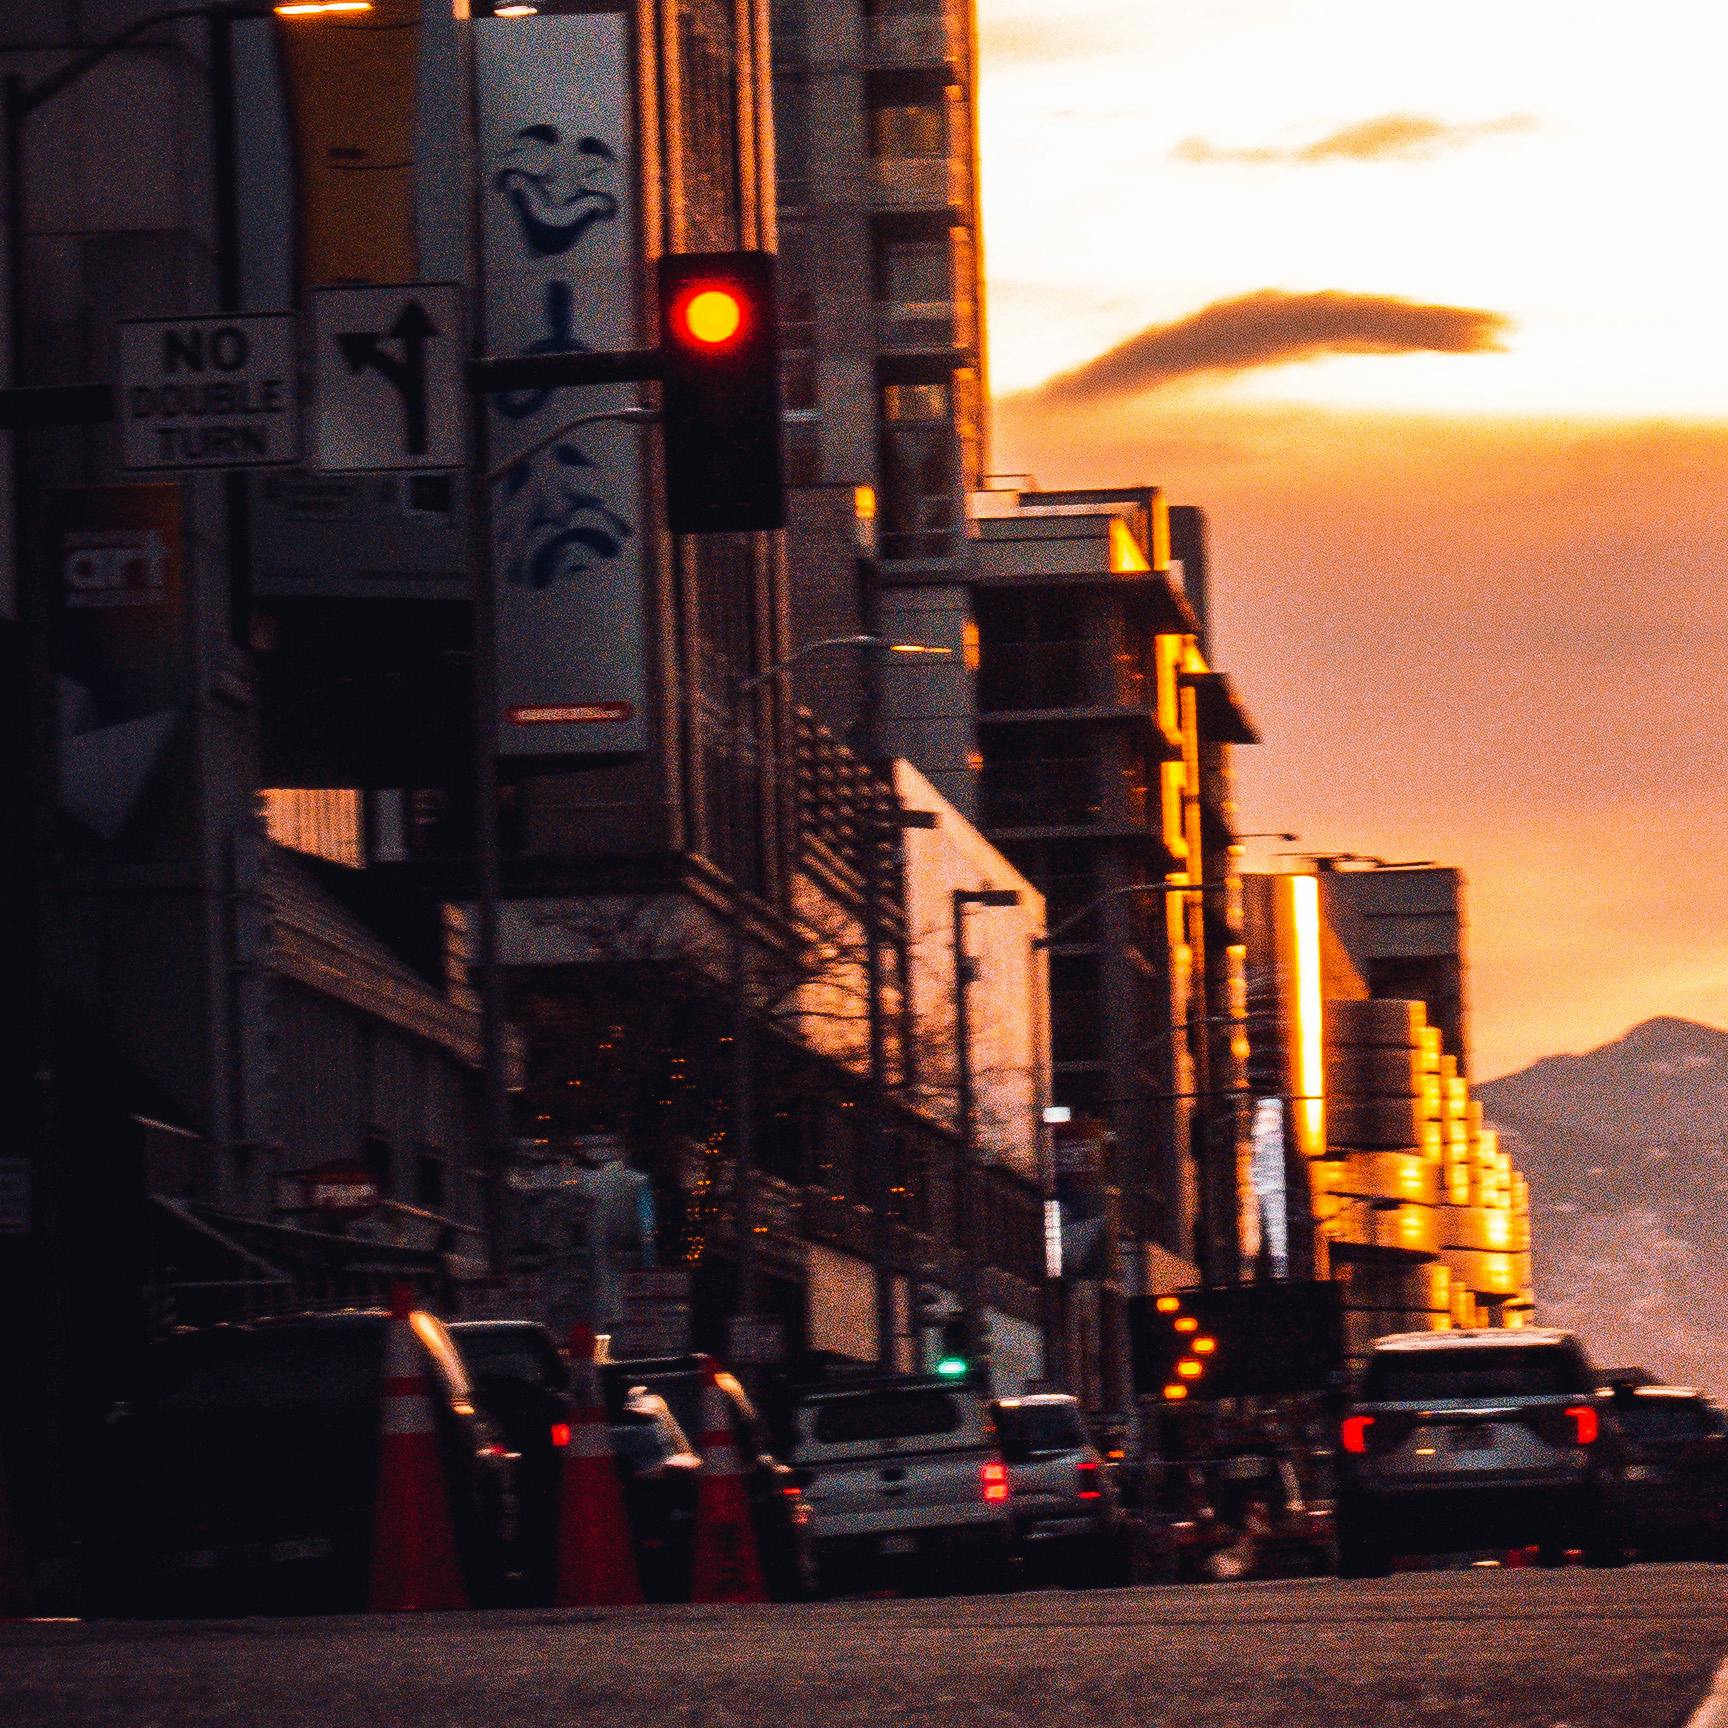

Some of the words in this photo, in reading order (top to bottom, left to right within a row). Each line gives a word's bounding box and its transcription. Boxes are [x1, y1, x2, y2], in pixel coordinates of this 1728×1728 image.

[162, 327, 249, 372] NO
[129, 379, 285, 418] DOUBLE
[155, 425, 268, 460] TURN
